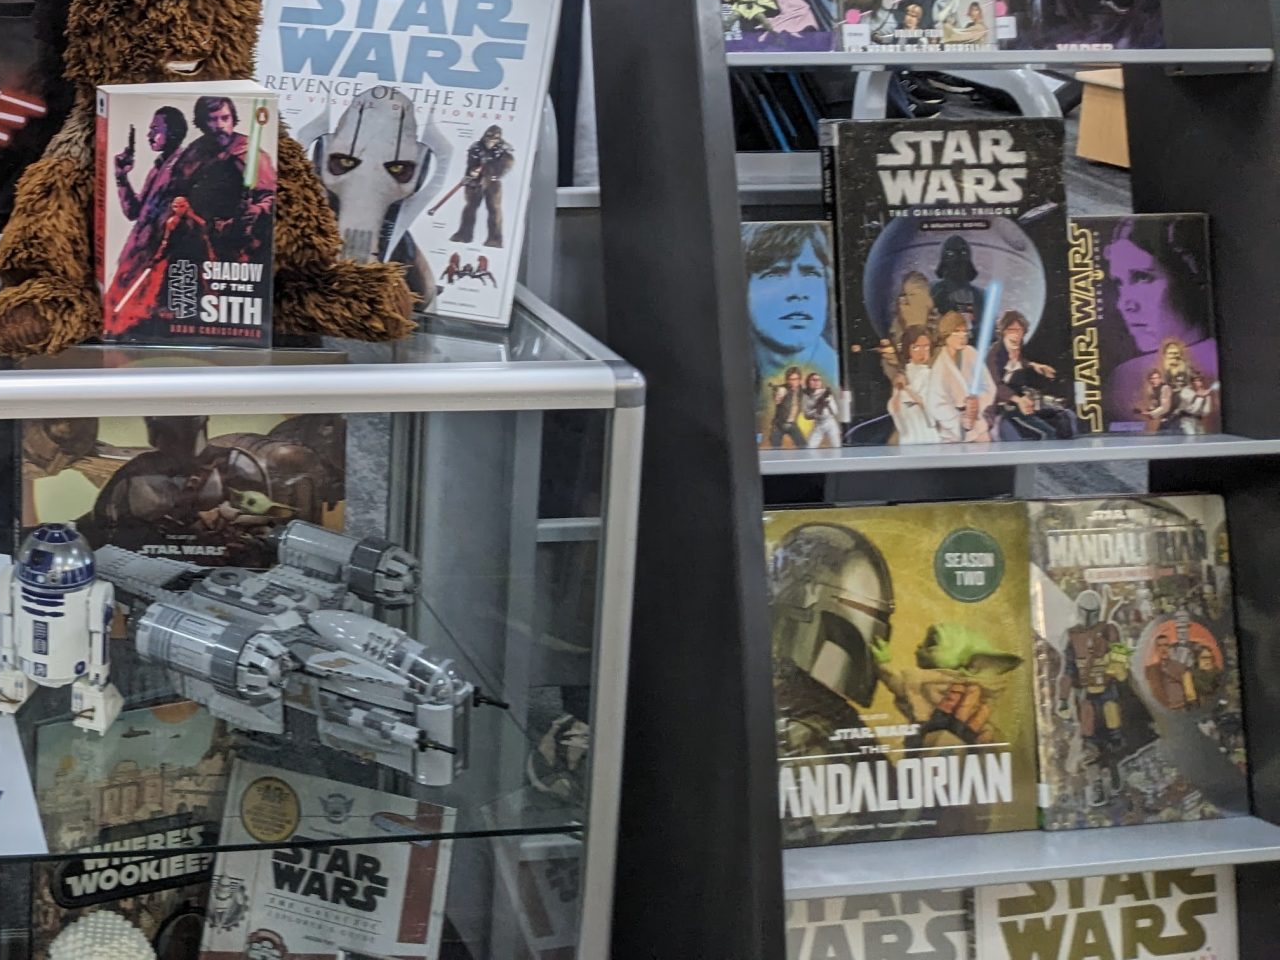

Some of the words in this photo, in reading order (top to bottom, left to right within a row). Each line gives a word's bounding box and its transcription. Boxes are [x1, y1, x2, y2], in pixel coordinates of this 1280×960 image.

[277, 26, 526, 90] WARS
[264, 74, 364, 97] REVENGE
[371, 85, 402, 101] OF
[410, 87, 453, 106] THE
[464, 93, 519, 112] SITH
[876, 129, 1027, 166] STAR
[877, 167, 1028, 206] WARS
[888, 209, 909, 217] THE
[912, 208, 968, 217] ORIGINAL
[970, 207, 1020, 216] TRILOGY
[202, 260, 264, 282] SHADOW
[210, 282, 228, 291] OF
[229, 283, 255, 292] THE
[1067, 222, 1097, 327] WARS
[200, 295, 262, 325] SITH
[1072, 327, 1104, 433] STAR
[137, 544, 181, 555] STAR
[181, 545, 227, 556] WARS
[944, 552, 995, 568] SEASON
[954, 570, 986, 586] TWO
[828, 727, 875, 741] STAR
[874, 723, 920, 737] WARS
[858, 744, 890, 754] THE
[779, 752, 1013, 819] ANDALORIAN
[66, 852, 214, 897] WOOKIEE?
[272, 836, 389, 888] STAR
[272, 861, 387, 912] WARS
[1000, 896, 1217, 960] WARS
